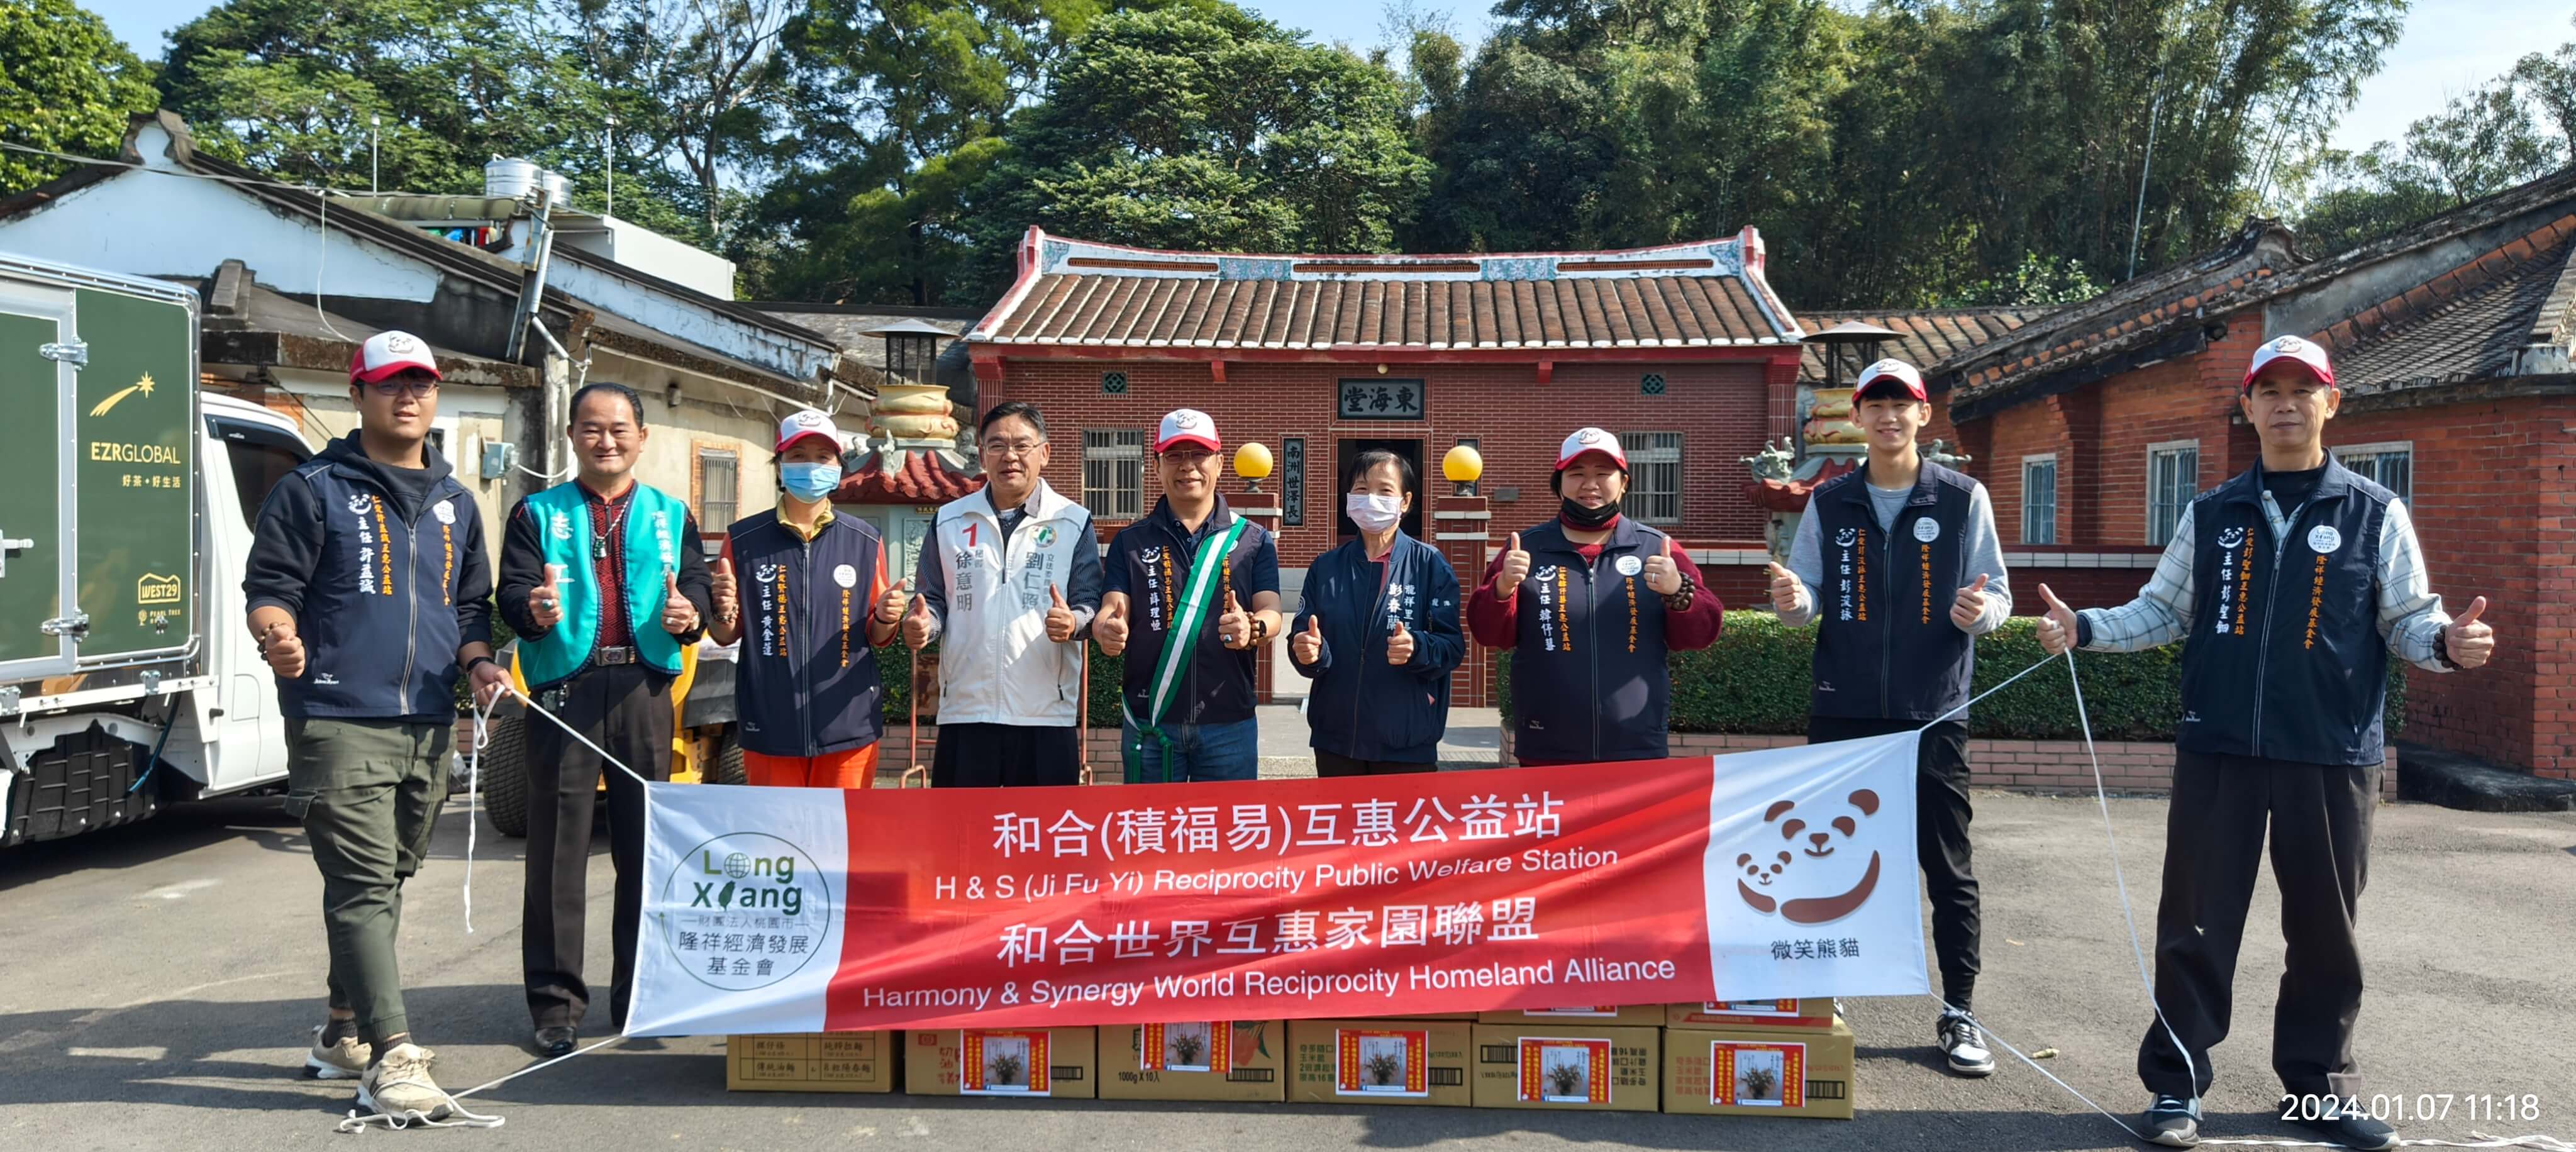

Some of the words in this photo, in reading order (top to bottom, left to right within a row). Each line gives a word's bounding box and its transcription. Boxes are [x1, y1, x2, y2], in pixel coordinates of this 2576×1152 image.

[91, 441, 181, 464] EZRGLOBAL
[358, 516, 373, 543] 主任
[962, 523, 979, 547] 1
[550, 511, 575, 584] 志工
[1840, 550, 1852, 575] 主任
[2221, 551, 2232, 581] 主任
[955, 551, 972, 612] 徐意明
[1147, 565, 1158, 589] 主任
[141, 584, 178, 599] WEST29
[761, 585, 773, 611] 主任
[1540, 582, 1551, 604] 主任
[993, 791, 1564, 861] 和合(積福易)互惠公益站
[935, 877, 955, 899] H
[966, 875, 985, 899] &
[995, 874, 1014, 898] S
[1024, 873, 1055, 903] (Ji
[1065, 872, 1098, 896] Fu
[1109, 871, 1143, 896] Yi)
[1153, 864, 1304, 895] Reciprocity
[1315, 862, 1400, 887] Public
[1409, 853, 1513, 880] Welfare
[1521, 846, 1619, 872] Station
[678, 931, 809, 955] 隆祥經濟發展
[996, 897, 1540, 968] 和合世界互惠家園聯盟
[1770, 938, 1860, 960] 微笑熊貓
[706, 956, 775, 977] 基金會
[863, 985, 992, 1011] Harmony
[1001, 982, 1020, 1004] &
[1030, 979, 1144, 1009] Synergy
[1153, 970, 1234, 999] World
[1245, 969, 1400, 1000] Reciprocity
[1409, 960, 1553, 991] Homeland
[1563, 956, 1675, 983] Alliance
